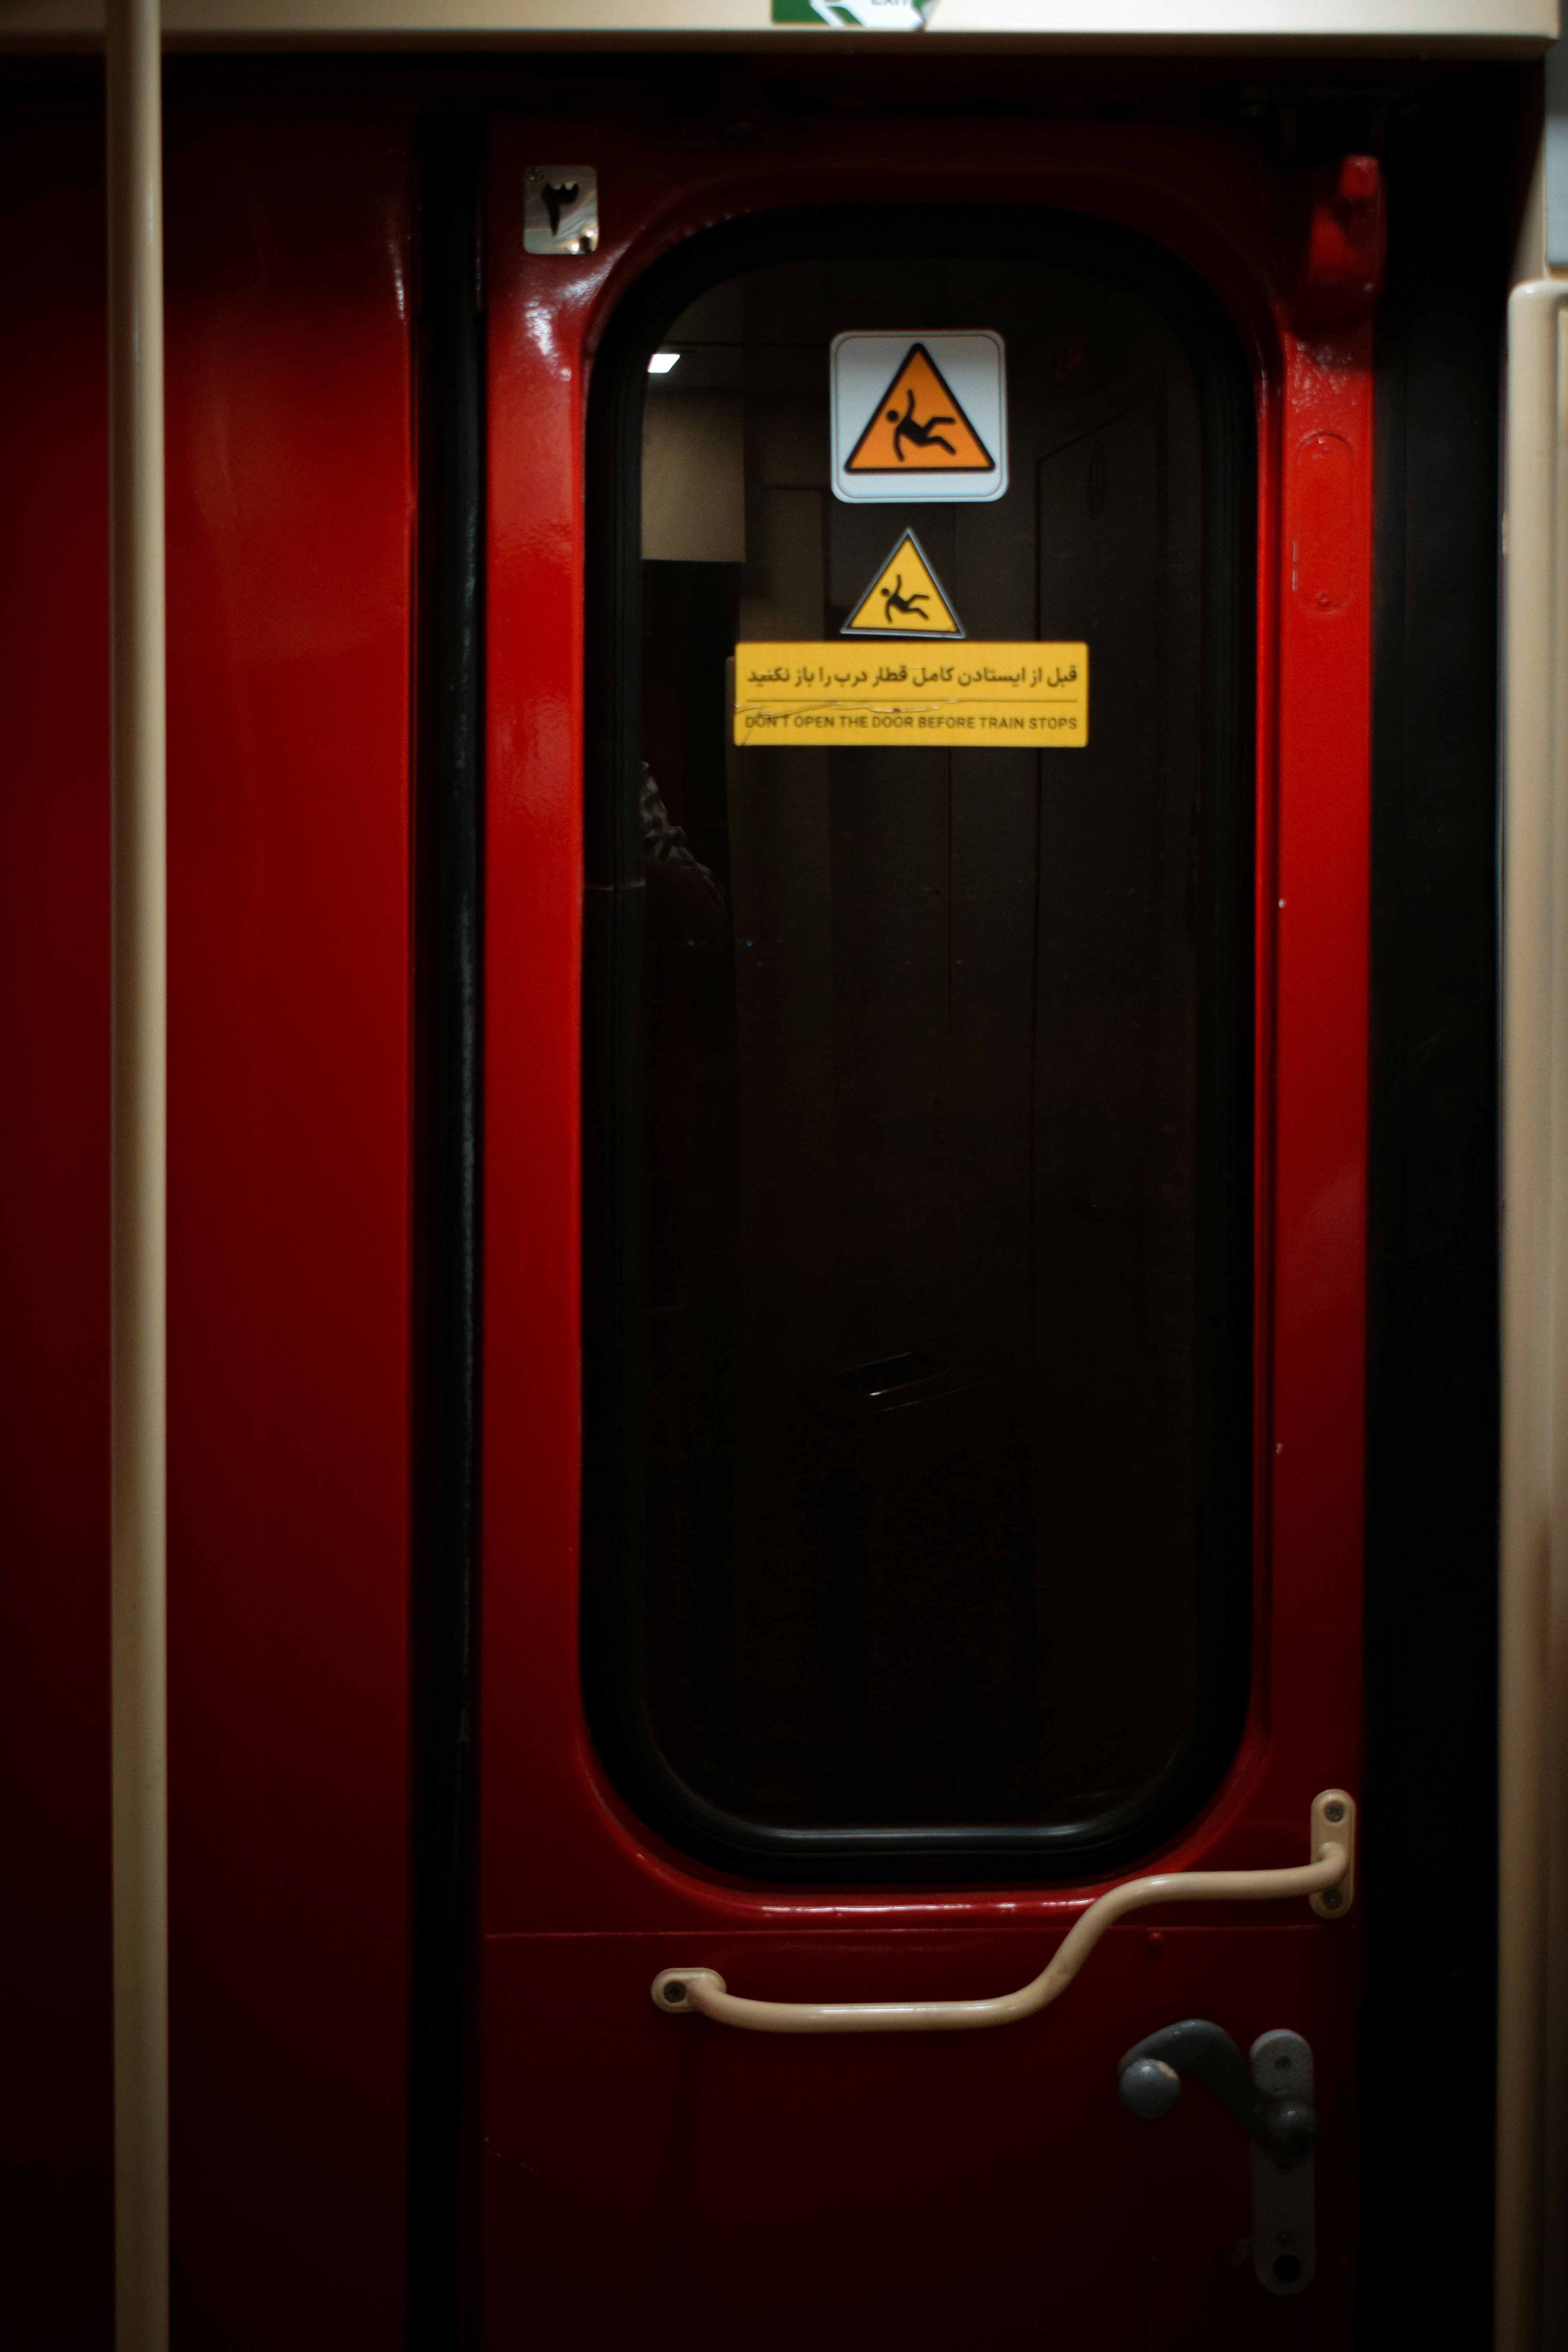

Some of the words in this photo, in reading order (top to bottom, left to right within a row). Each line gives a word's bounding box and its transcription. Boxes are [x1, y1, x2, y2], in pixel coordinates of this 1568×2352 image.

[748, 666, 790, 687] نکنید
[794, 667, 815, 687] باز
[819, 667, 831, 687] را
[833, 670, 868, 687] درب
[872, 664, 908, 687] قطار
[912, 666, 955, 687] کامل
[958, 667, 1026, 687] ایستادن
[1030, 667, 1043, 687] از
[1047, 665, 1077, 687] قبل
[746, 715, 789, 728] DONT
[794, 716, 835, 728] OPEN
[839, 716, 867, 728] THE
[872, 716, 913, 728] DOOR
[918, 716, 975, 729] BEFORE
[979, 716, 1025, 729] TRAIN
[1029, 717, 1077, 730] STOPS
